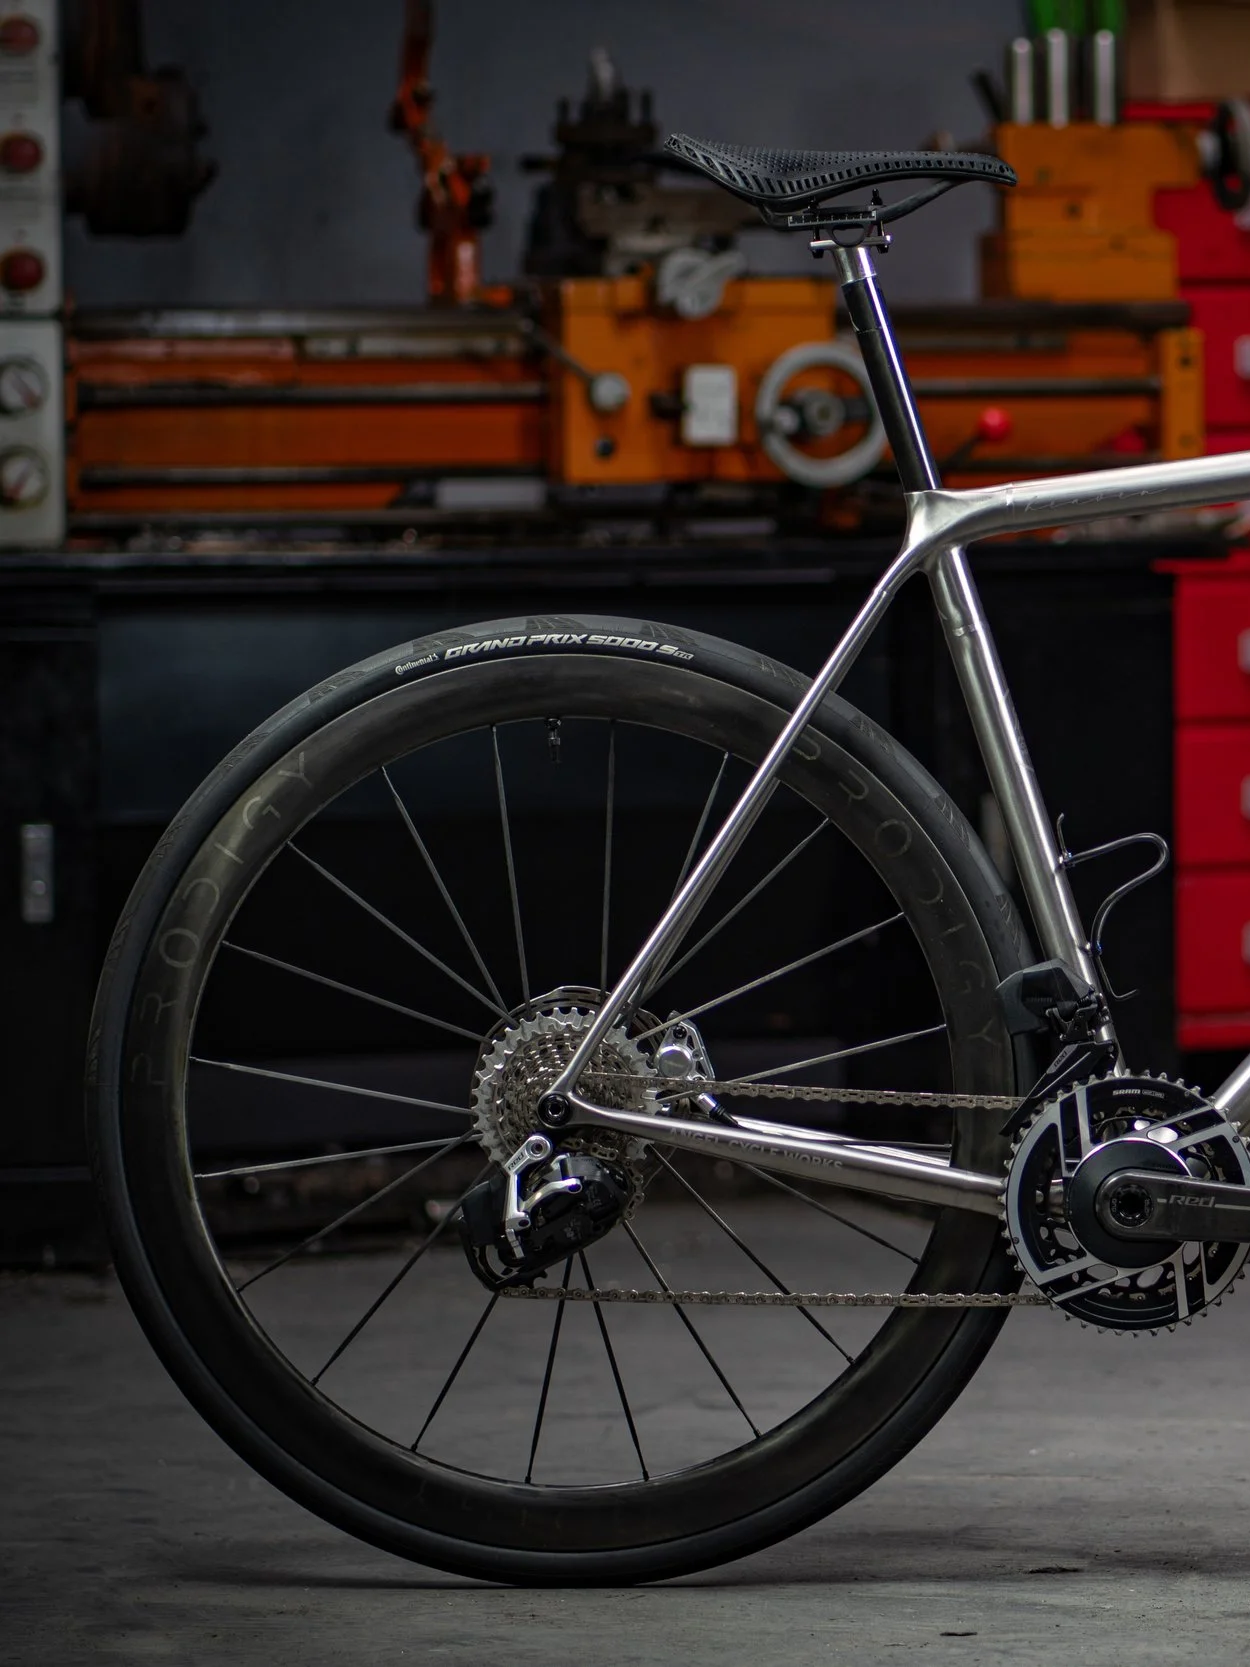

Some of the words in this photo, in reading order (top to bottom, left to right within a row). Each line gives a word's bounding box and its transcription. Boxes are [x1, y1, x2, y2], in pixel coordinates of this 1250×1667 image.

[444, 636, 527, 660] GRAND
[526, 633, 588, 645] PRIX
[586, 634, 659, 651] 5000
